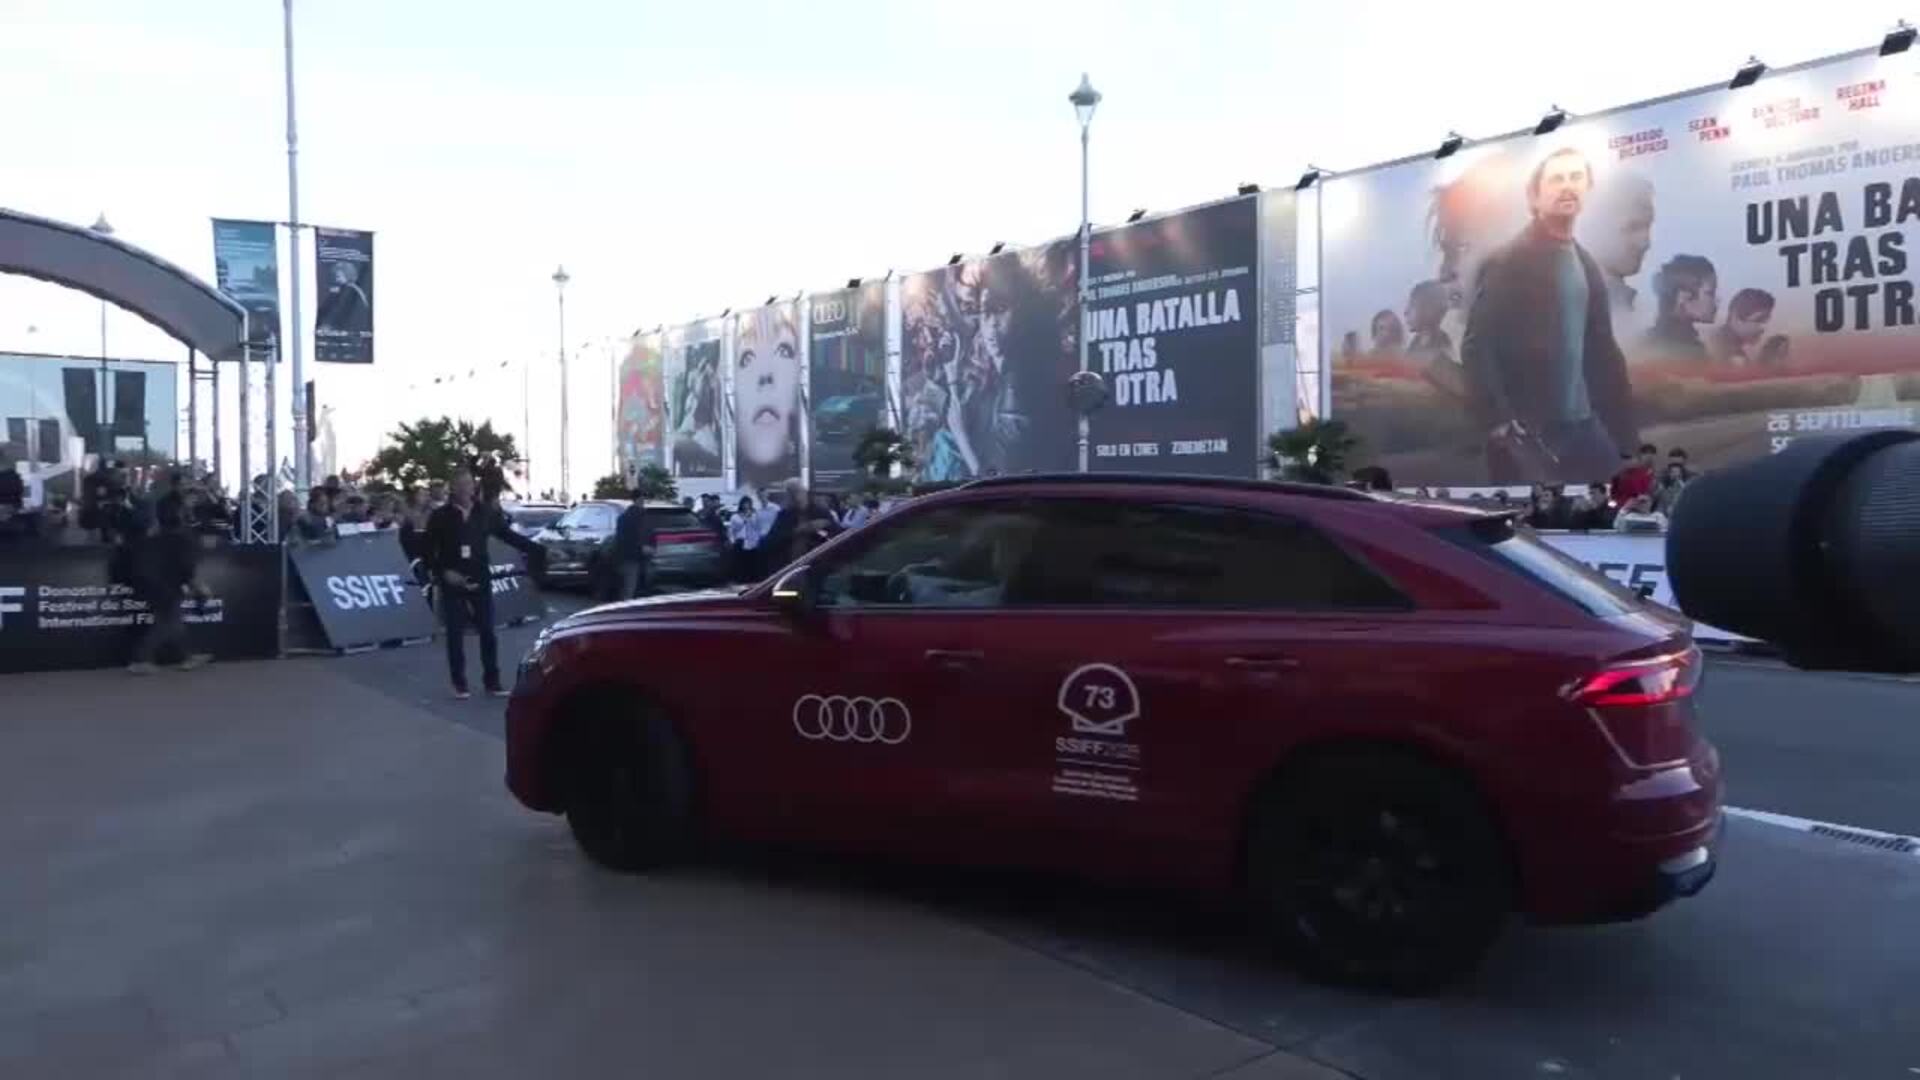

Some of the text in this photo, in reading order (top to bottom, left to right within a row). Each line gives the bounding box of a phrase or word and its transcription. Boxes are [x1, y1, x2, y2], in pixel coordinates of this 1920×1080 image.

[1688, 117, 1718, 132] SEAN
[1699, 126, 1731, 142] PENN
[1731, 170, 1771, 191] PAUL
[1776, 155, 1848, 183] THOMAS
[1747, 177, 1920, 245] UNA BA
[1779, 231, 1907, 288] TRAS
[1087, 289, 1240, 342] UNA BATALLA
[1815, 280, 1920, 333] OTR
[1100, 337, 1156, 373] TRAS
[1116, 368, 1177, 406] OTRA
[38, 585, 107, 597] Donostia
[38, 600, 98, 613] Festival
[100, 600, 120, 612] de
[327, 574, 405, 610] SSIFF
[38, 614, 134, 628] International
[1084, 685, 1117, 709] 73
